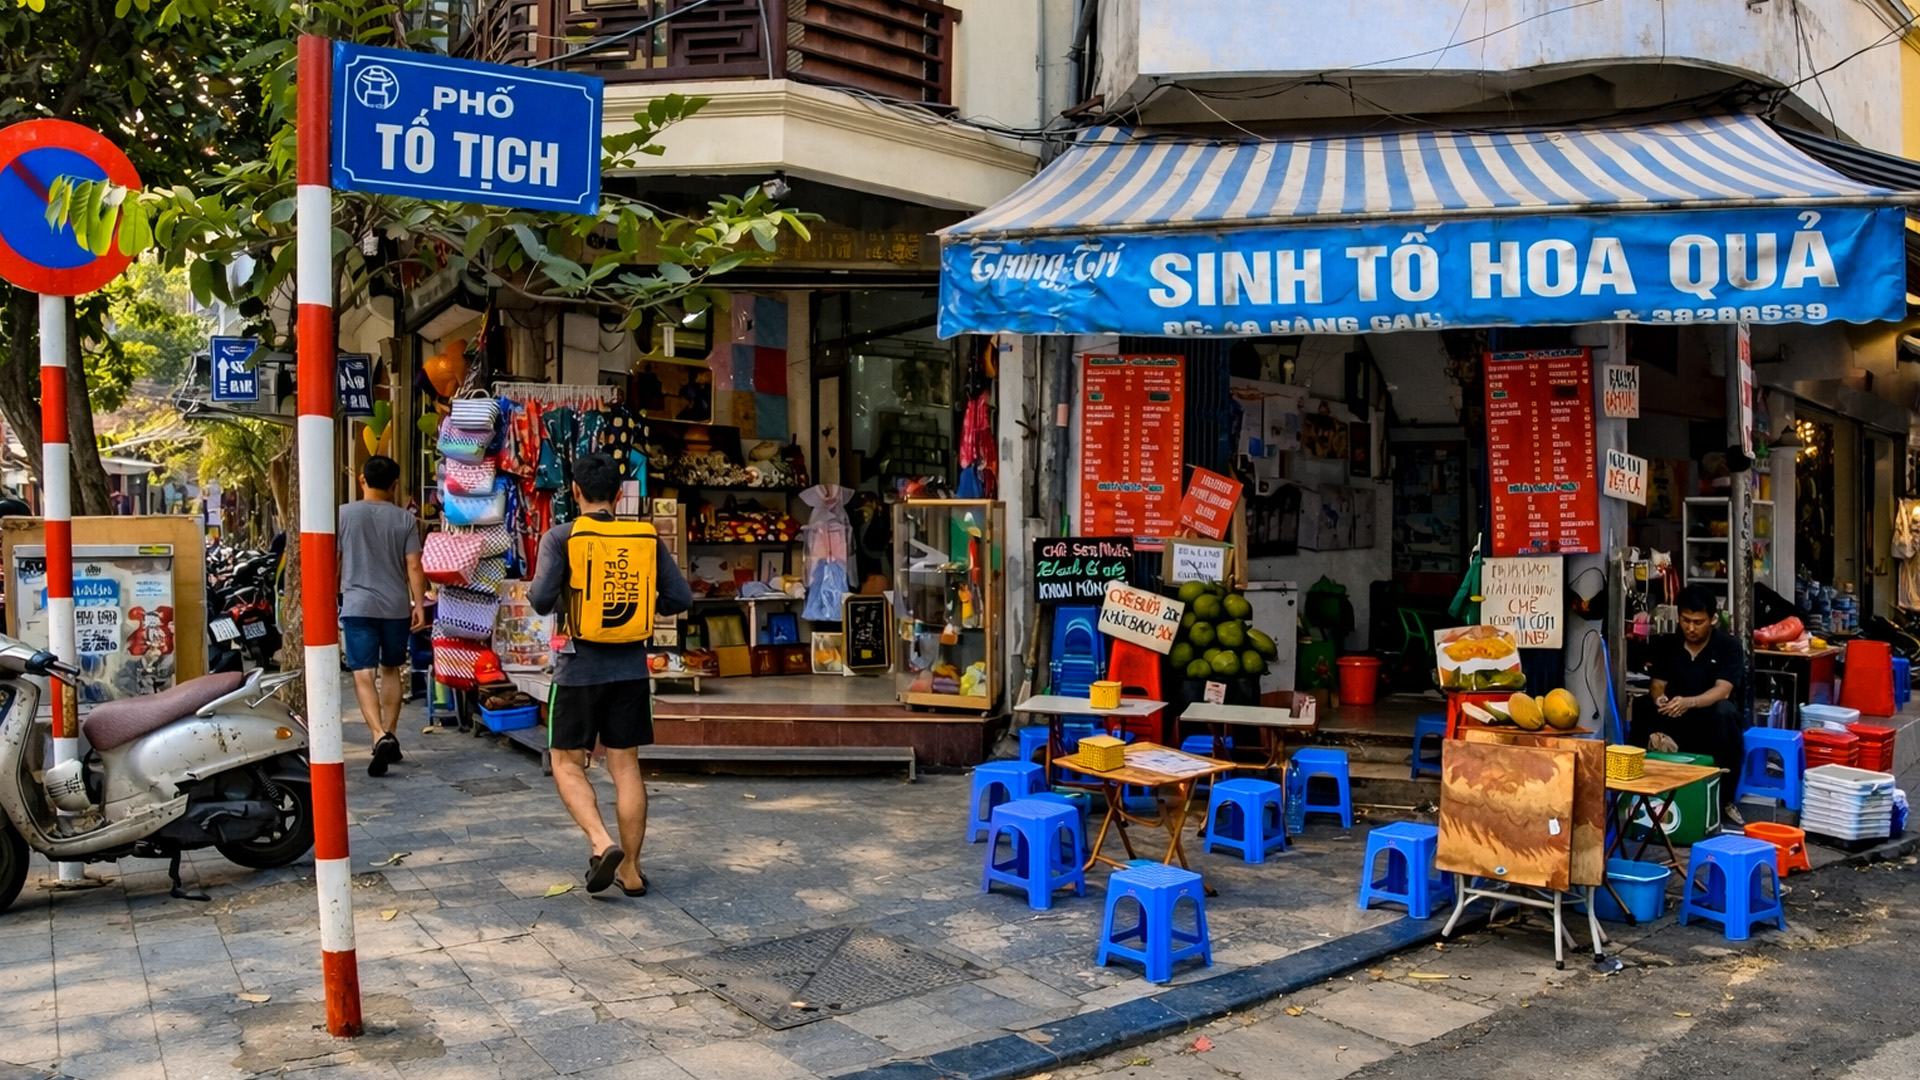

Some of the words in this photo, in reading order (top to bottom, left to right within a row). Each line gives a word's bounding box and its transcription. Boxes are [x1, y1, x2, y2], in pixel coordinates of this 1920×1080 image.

[433, 85, 516, 118] PHỐ
[375, 108, 436, 174] TỐ
[453, 131, 559, 190] TỊCH
[1148, 247, 1323, 308] SINH
[1346, 221, 1443, 302] TỐ
[1470, 237, 1637, 299] HOA
[1668, 211, 1840, 300] QUẢ
[603, 561, 617, 601] FACE
